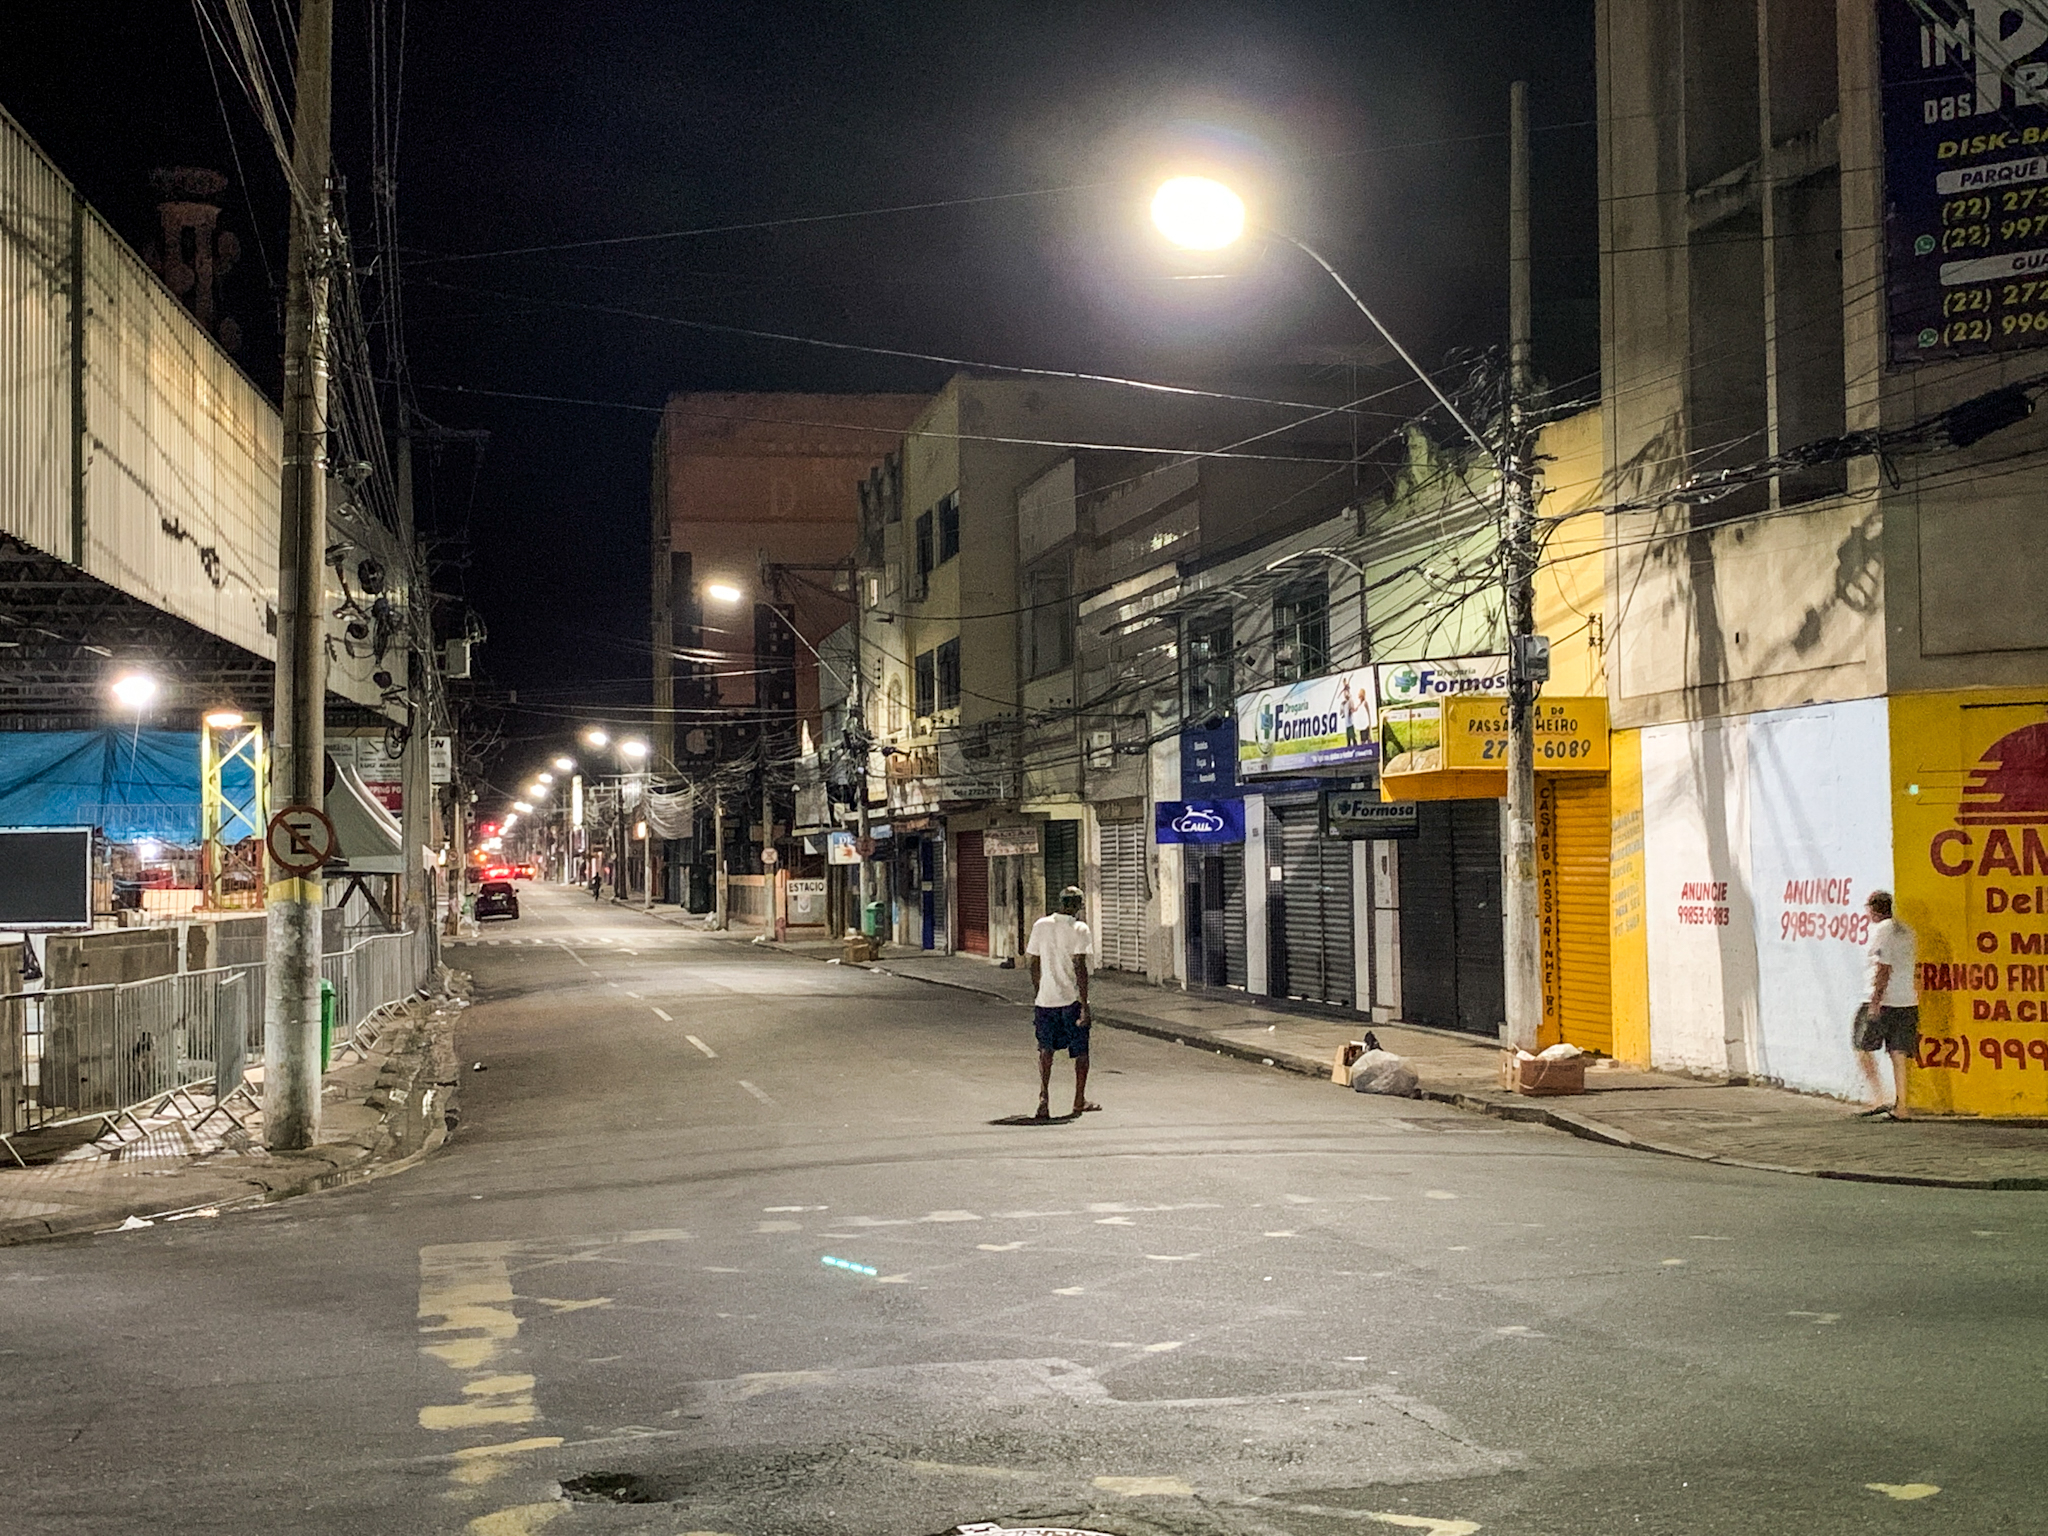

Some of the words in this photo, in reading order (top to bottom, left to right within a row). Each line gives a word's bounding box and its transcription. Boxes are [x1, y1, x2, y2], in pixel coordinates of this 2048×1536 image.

[1960, 160, 2040, 188] PARQUE
[1942, 195, 1991, 226] (22)
[1941, 223, 1991, 254] (22)
[1943, 288, 1992, 318] (22)
[1943, 319, 1992, 347] (22)
[2001, 311, 2048, 336] 996
[1419, 670, 1508, 694] Formos
[1275, 705, 1338, 742] Formosa
[1500, 705, 1542, 716] CA
[1468, 719, 1578, 732] PASSAHEIRO
[1482, 740, 1592, 759] 27-6089
[1352, 800, 1415, 817] Formosa
[1540, 787, 1551, 838] CASA
[290, 823, 312, 855] E
[788, 882, 825, 893] ESTACIO
[1681, 882, 1728, 901] ANUNCIE
[1783, 877, 1853, 906] ANUNCIE
[1986, 886, 2048, 914] Del
[1677, 905, 1730, 926] 99853-0983
[1781, 910, 1870, 946] 99853-0983
[1542, 869, 1554, 1017] PASSARINHEIRO
[1976, 930, 1999, 954] O
[2007, 964, 2048, 992] FRI
[1973, 1000, 2012, 1021] DA
[2017, 1000, 2048, 1022] CI
[1916, 1033, 1970, 1074] (22)
[1979, 1037, 2048, 1071] 999
